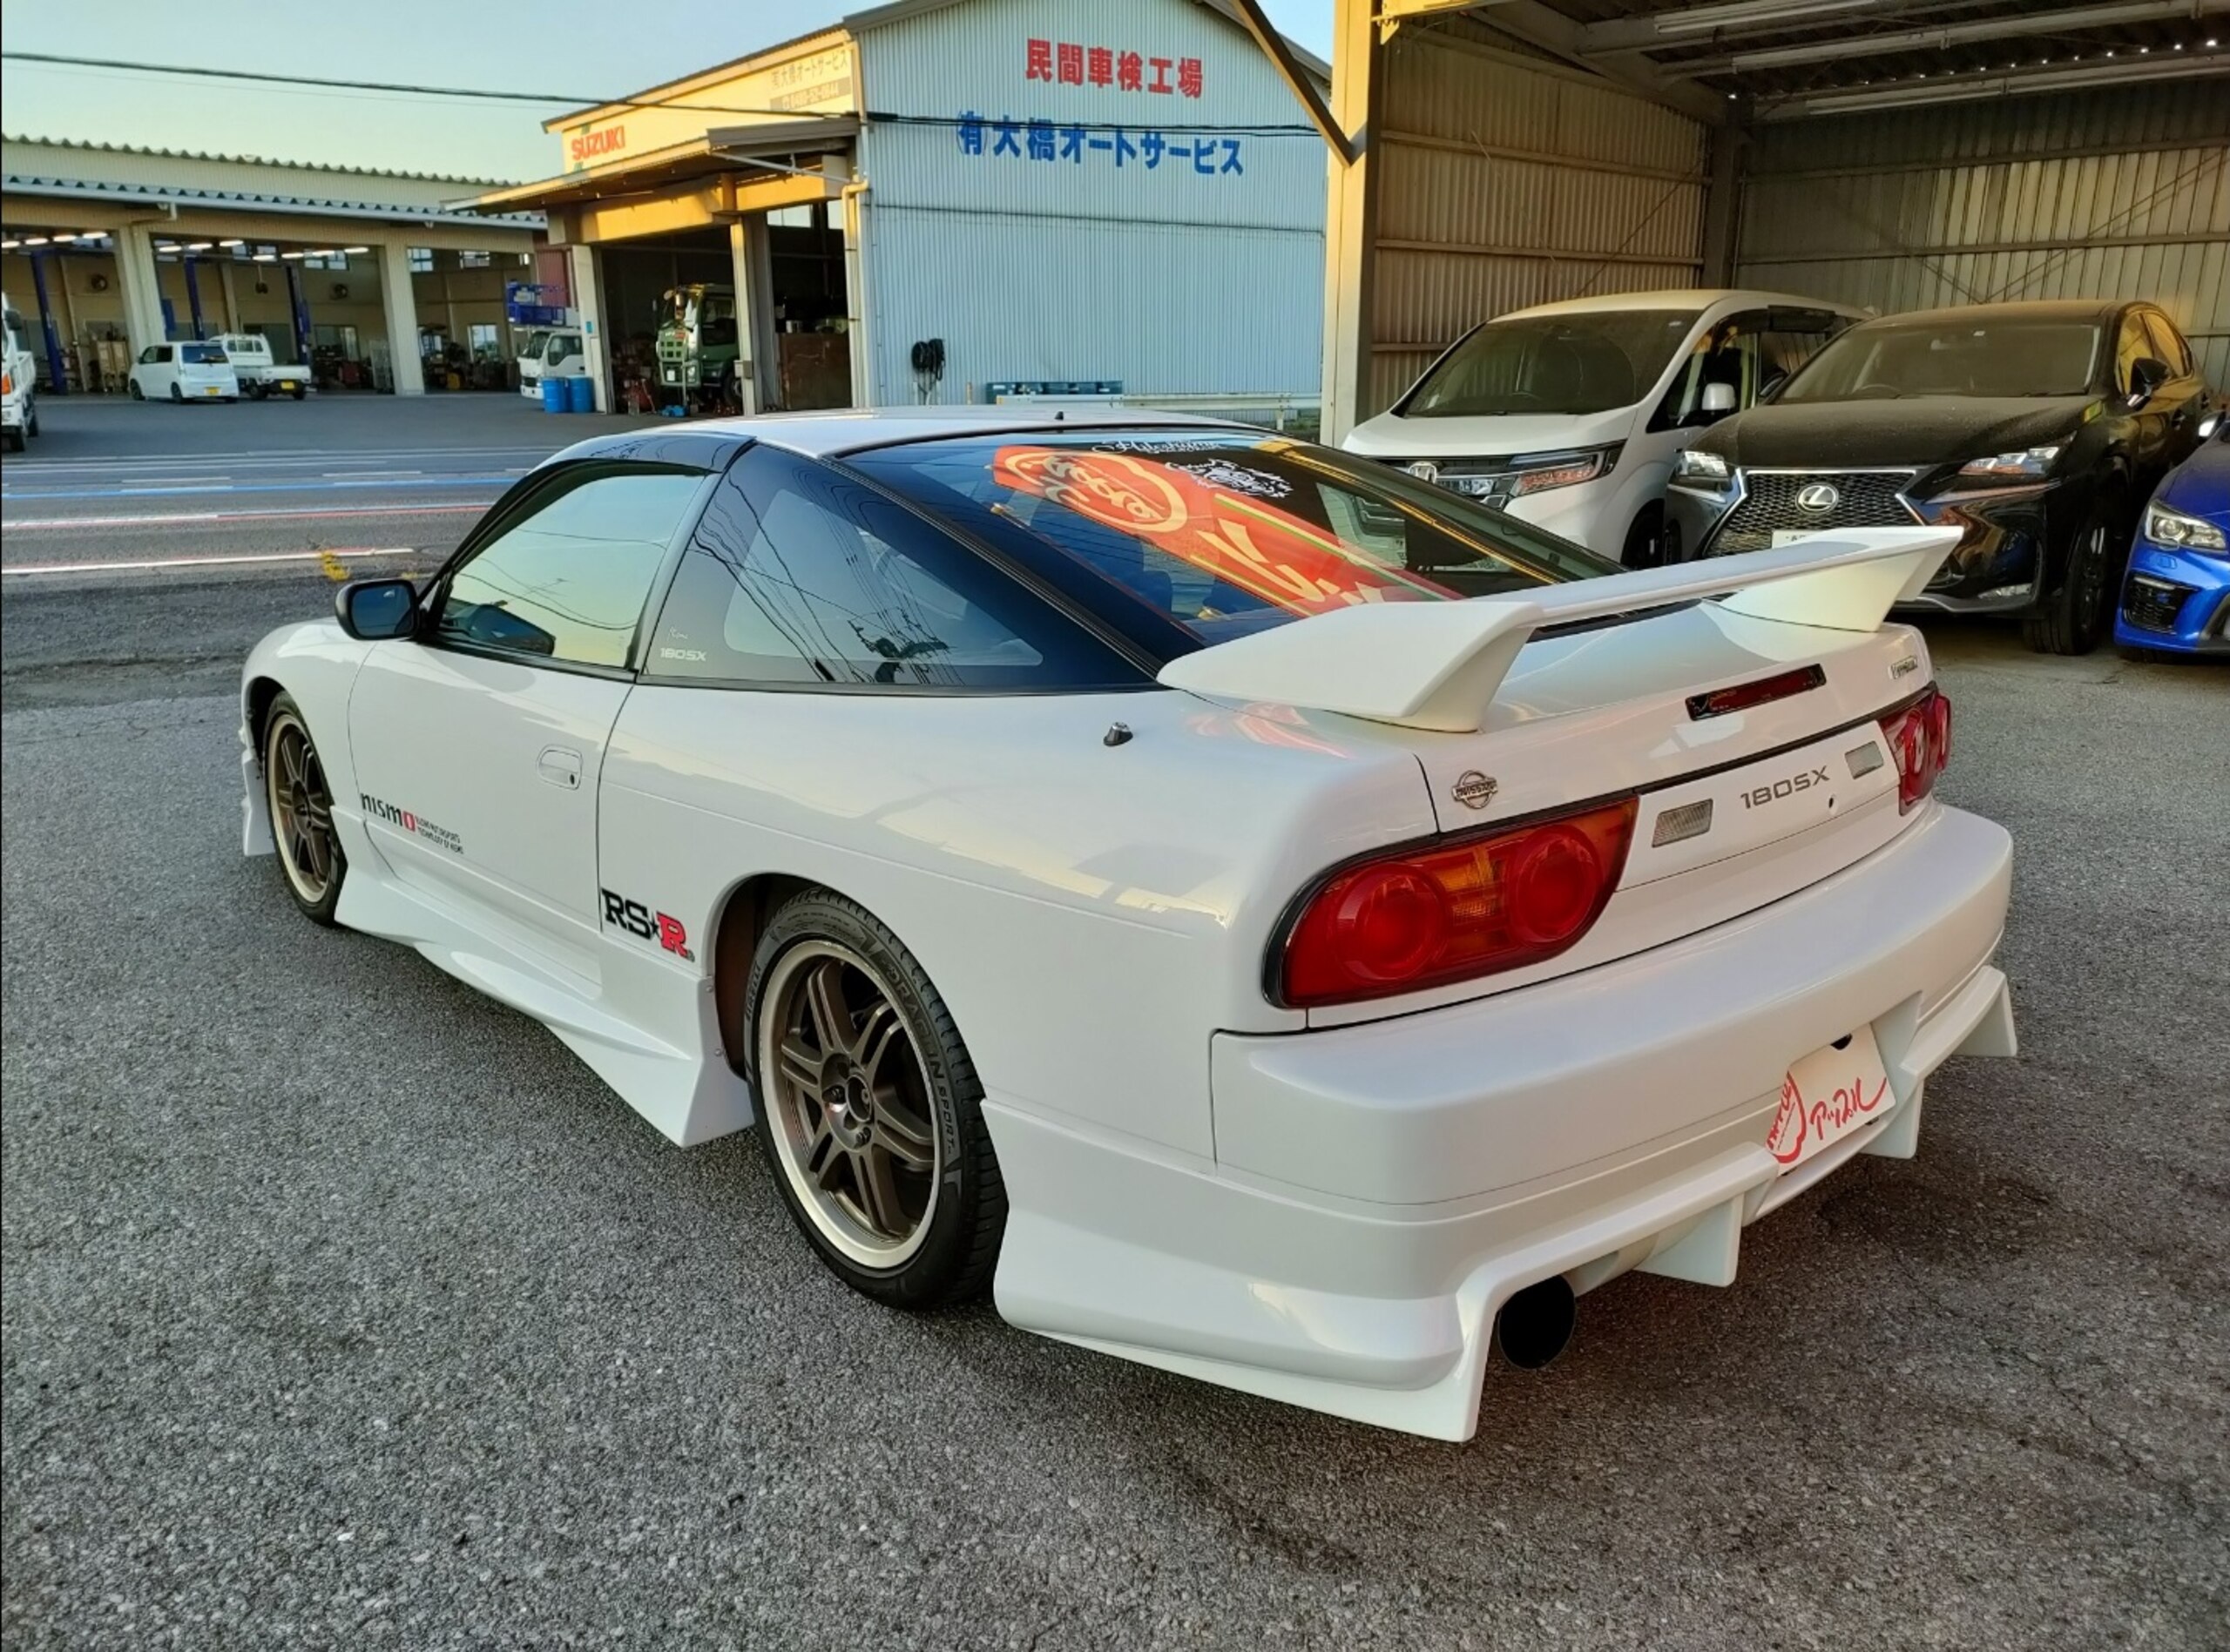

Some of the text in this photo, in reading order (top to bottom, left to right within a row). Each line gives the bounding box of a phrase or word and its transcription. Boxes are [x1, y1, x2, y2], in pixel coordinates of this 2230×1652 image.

[1026, 37, 1203, 98] 民間車検工場
[571, 125, 626, 161] SUZUKI
[660, 647, 707, 662] 180SX
[1740, 765, 1830, 810] 180SX
[360, 792, 416, 833] nismo
